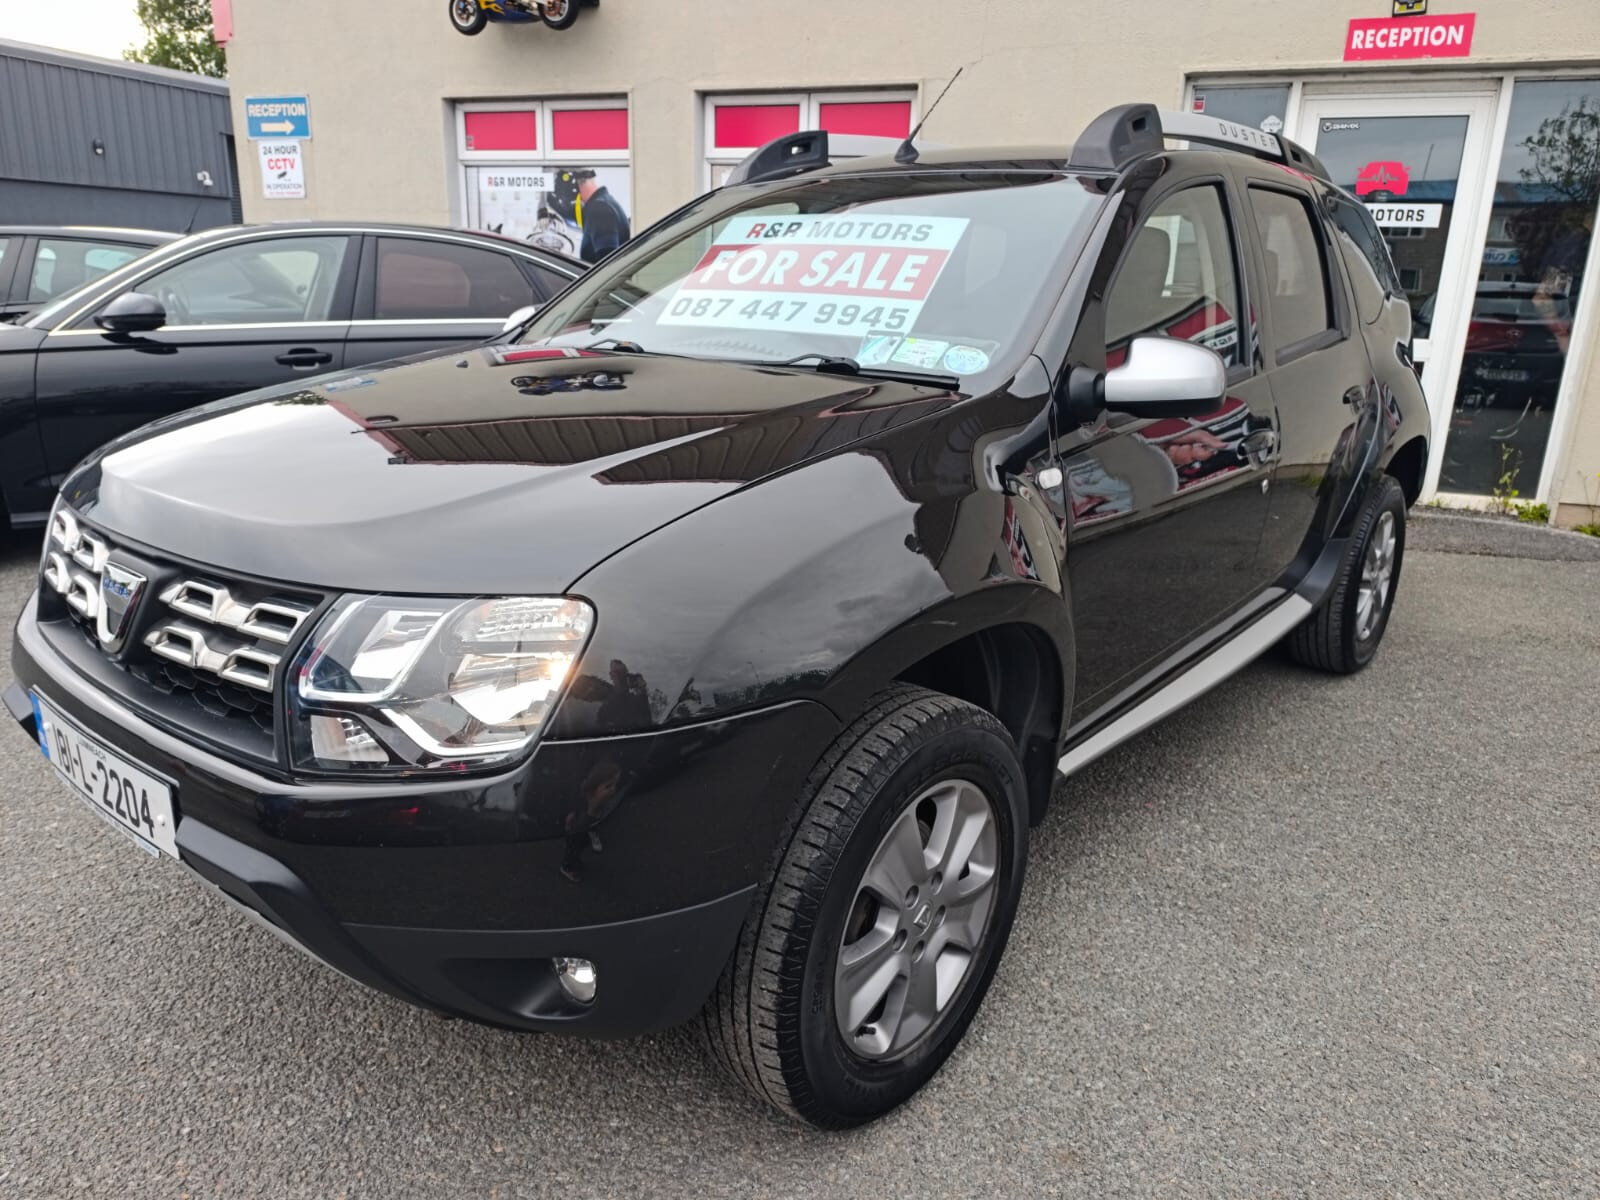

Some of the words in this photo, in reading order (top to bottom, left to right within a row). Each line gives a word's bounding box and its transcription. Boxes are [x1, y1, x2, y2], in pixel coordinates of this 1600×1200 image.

[1351, 25, 1464, 49] RECEPTION
[249, 104, 306, 116] RECEPTION
[1219, 123, 1276, 150] DUSTER
[262, 146, 272, 155] 24
[274, 145, 298, 154] HOUR
[267, 159, 295, 170] CCTV
[507, 176, 545, 187] MOTORS
[746, 222, 802, 238] R&R
[807, 222, 933, 241] MOTORS
[700, 249, 799, 285] FOR
[799, 250, 929, 292] SALE
[670, 298, 735, 318] 087
[739, 300, 808, 322] 447
[813, 303, 910, 330] 9945
[52, 723, 155, 838] 181-L-2204
